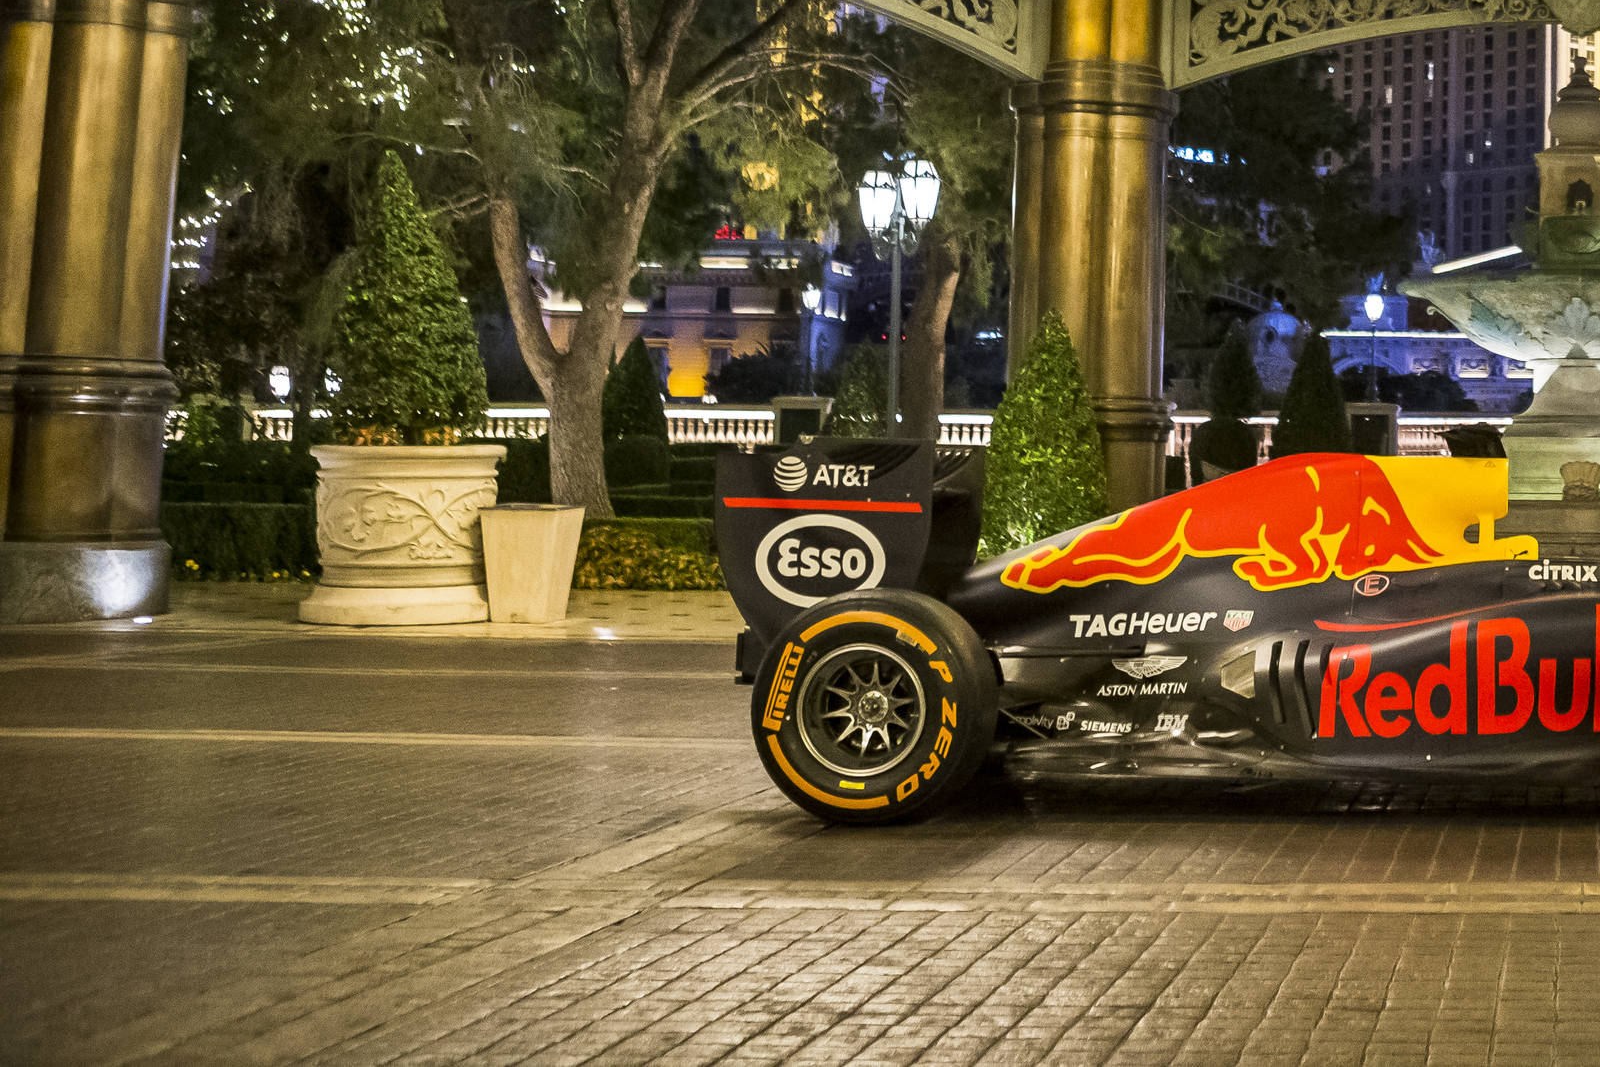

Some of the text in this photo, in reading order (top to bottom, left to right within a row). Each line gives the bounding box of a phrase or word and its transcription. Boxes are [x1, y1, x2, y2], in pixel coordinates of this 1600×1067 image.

[812, 464, 875, 488] AT&T
[1363, 576, 1381, 593] E
[762, 641, 805, 732] PIRELLI
[1097, 682, 1188, 697] ASTON MARTIN
[896, 659, 957, 803] P ZERO
[1080, 720, 1133, 734] SIEMENS
[1154, 714, 1189, 732] IBM
